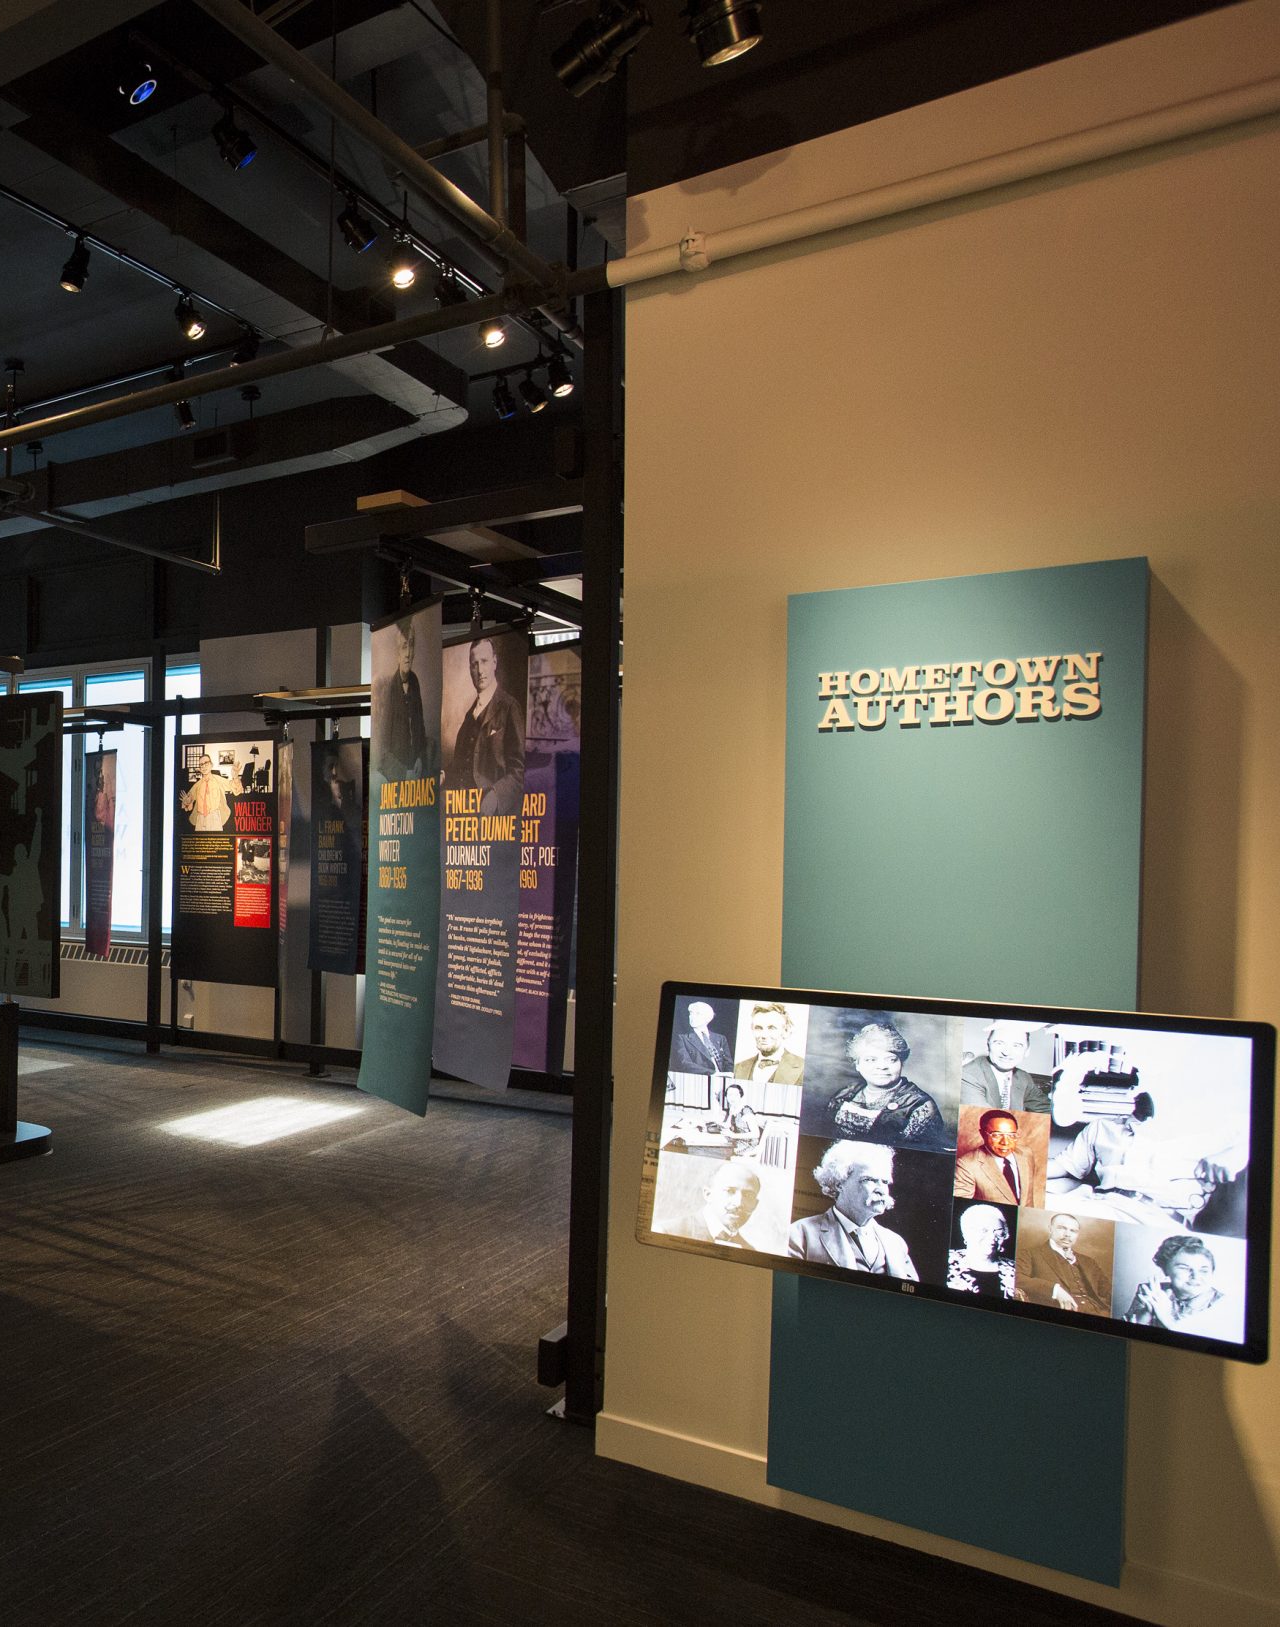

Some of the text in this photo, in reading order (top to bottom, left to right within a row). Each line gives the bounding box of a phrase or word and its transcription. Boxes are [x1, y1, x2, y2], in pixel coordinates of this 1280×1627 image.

[817, 652, 1103, 699] HOMETOWN
[817, 682, 1102, 731] AUTHORS
[380, 777, 436, 810] JANE ADDAMS
[446, 788, 483, 814] FINLEY
[522, 792, 546, 817] ARD
[234, 801, 267, 817] WALTER
[234, 816, 272, 832] YOUNGER
[380, 812, 414, 836] NONFICTION
[446, 815, 516, 842] PETER DUNNE
[379, 840, 400, 862] WRITER
[445, 845, 491, 866] JOURNALIST
[520, 846, 536, 868] IST,
[446, 870, 484, 891] 1867-1936
